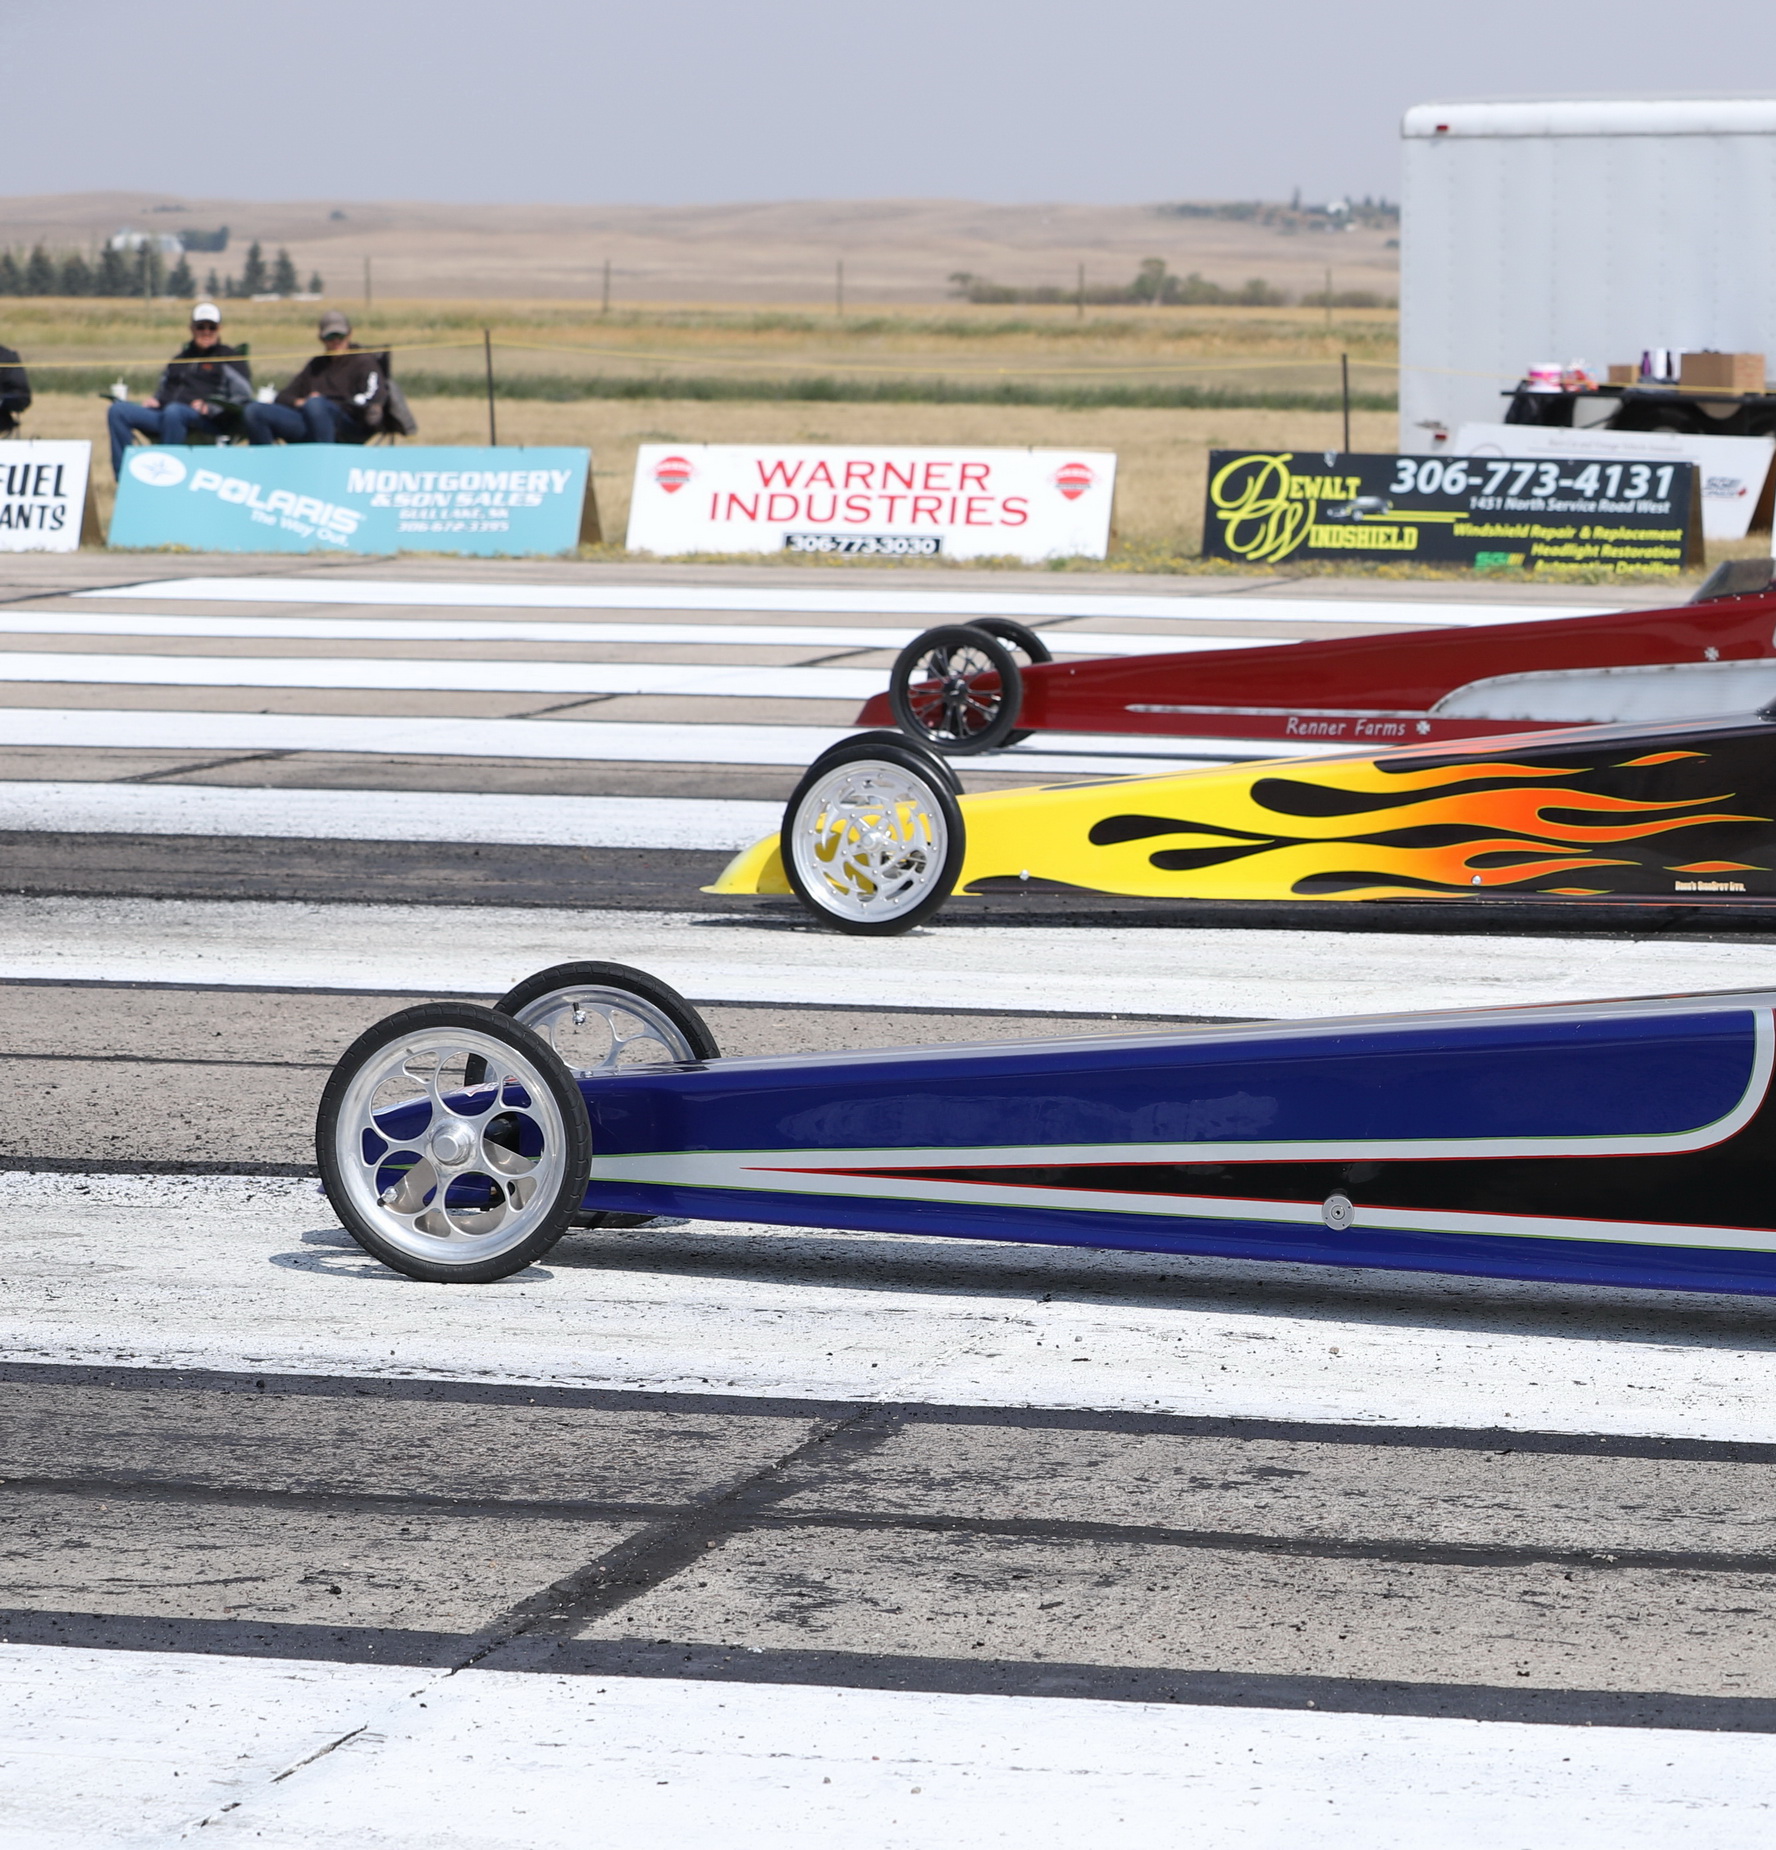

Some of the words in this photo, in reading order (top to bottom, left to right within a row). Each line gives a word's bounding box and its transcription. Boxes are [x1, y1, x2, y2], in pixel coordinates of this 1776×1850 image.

[0, 464, 68, 497] UEL
[346, 467, 572, 494] MONTGOMERY
[757, 460, 991, 492] WARNER
[1389, 458, 1675, 499] 306-773-4131
[189, 468, 363, 535] POLARIS
[454, 492, 545, 508] SALES
[709, 492, 1029, 526] INDUSTRIES
[1504, 497, 1545, 512] North
[1546, 498, 1597, 513] Service
[1598, 499, 1636, 513] Road
[1637, 500, 1671, 514] West
[250, 509, 278, 526] The
[280, 516, 315, 539] Way
[1453, 523, 1530, 539] Windshield
[1531, 525, 1577, 541] Repair
[1579, 526, 1592, 539] &
[1593, 526, 1684, 542] Replacement
[789, 535, 937, 554] 306-773-3030
[1531, 543, 1599, 560] Headlight
[1600, 544, 1682, 559] Restoration
[1286, 716, 1347, 736] Renner
[1354, 718, 1406, 736] Farms
